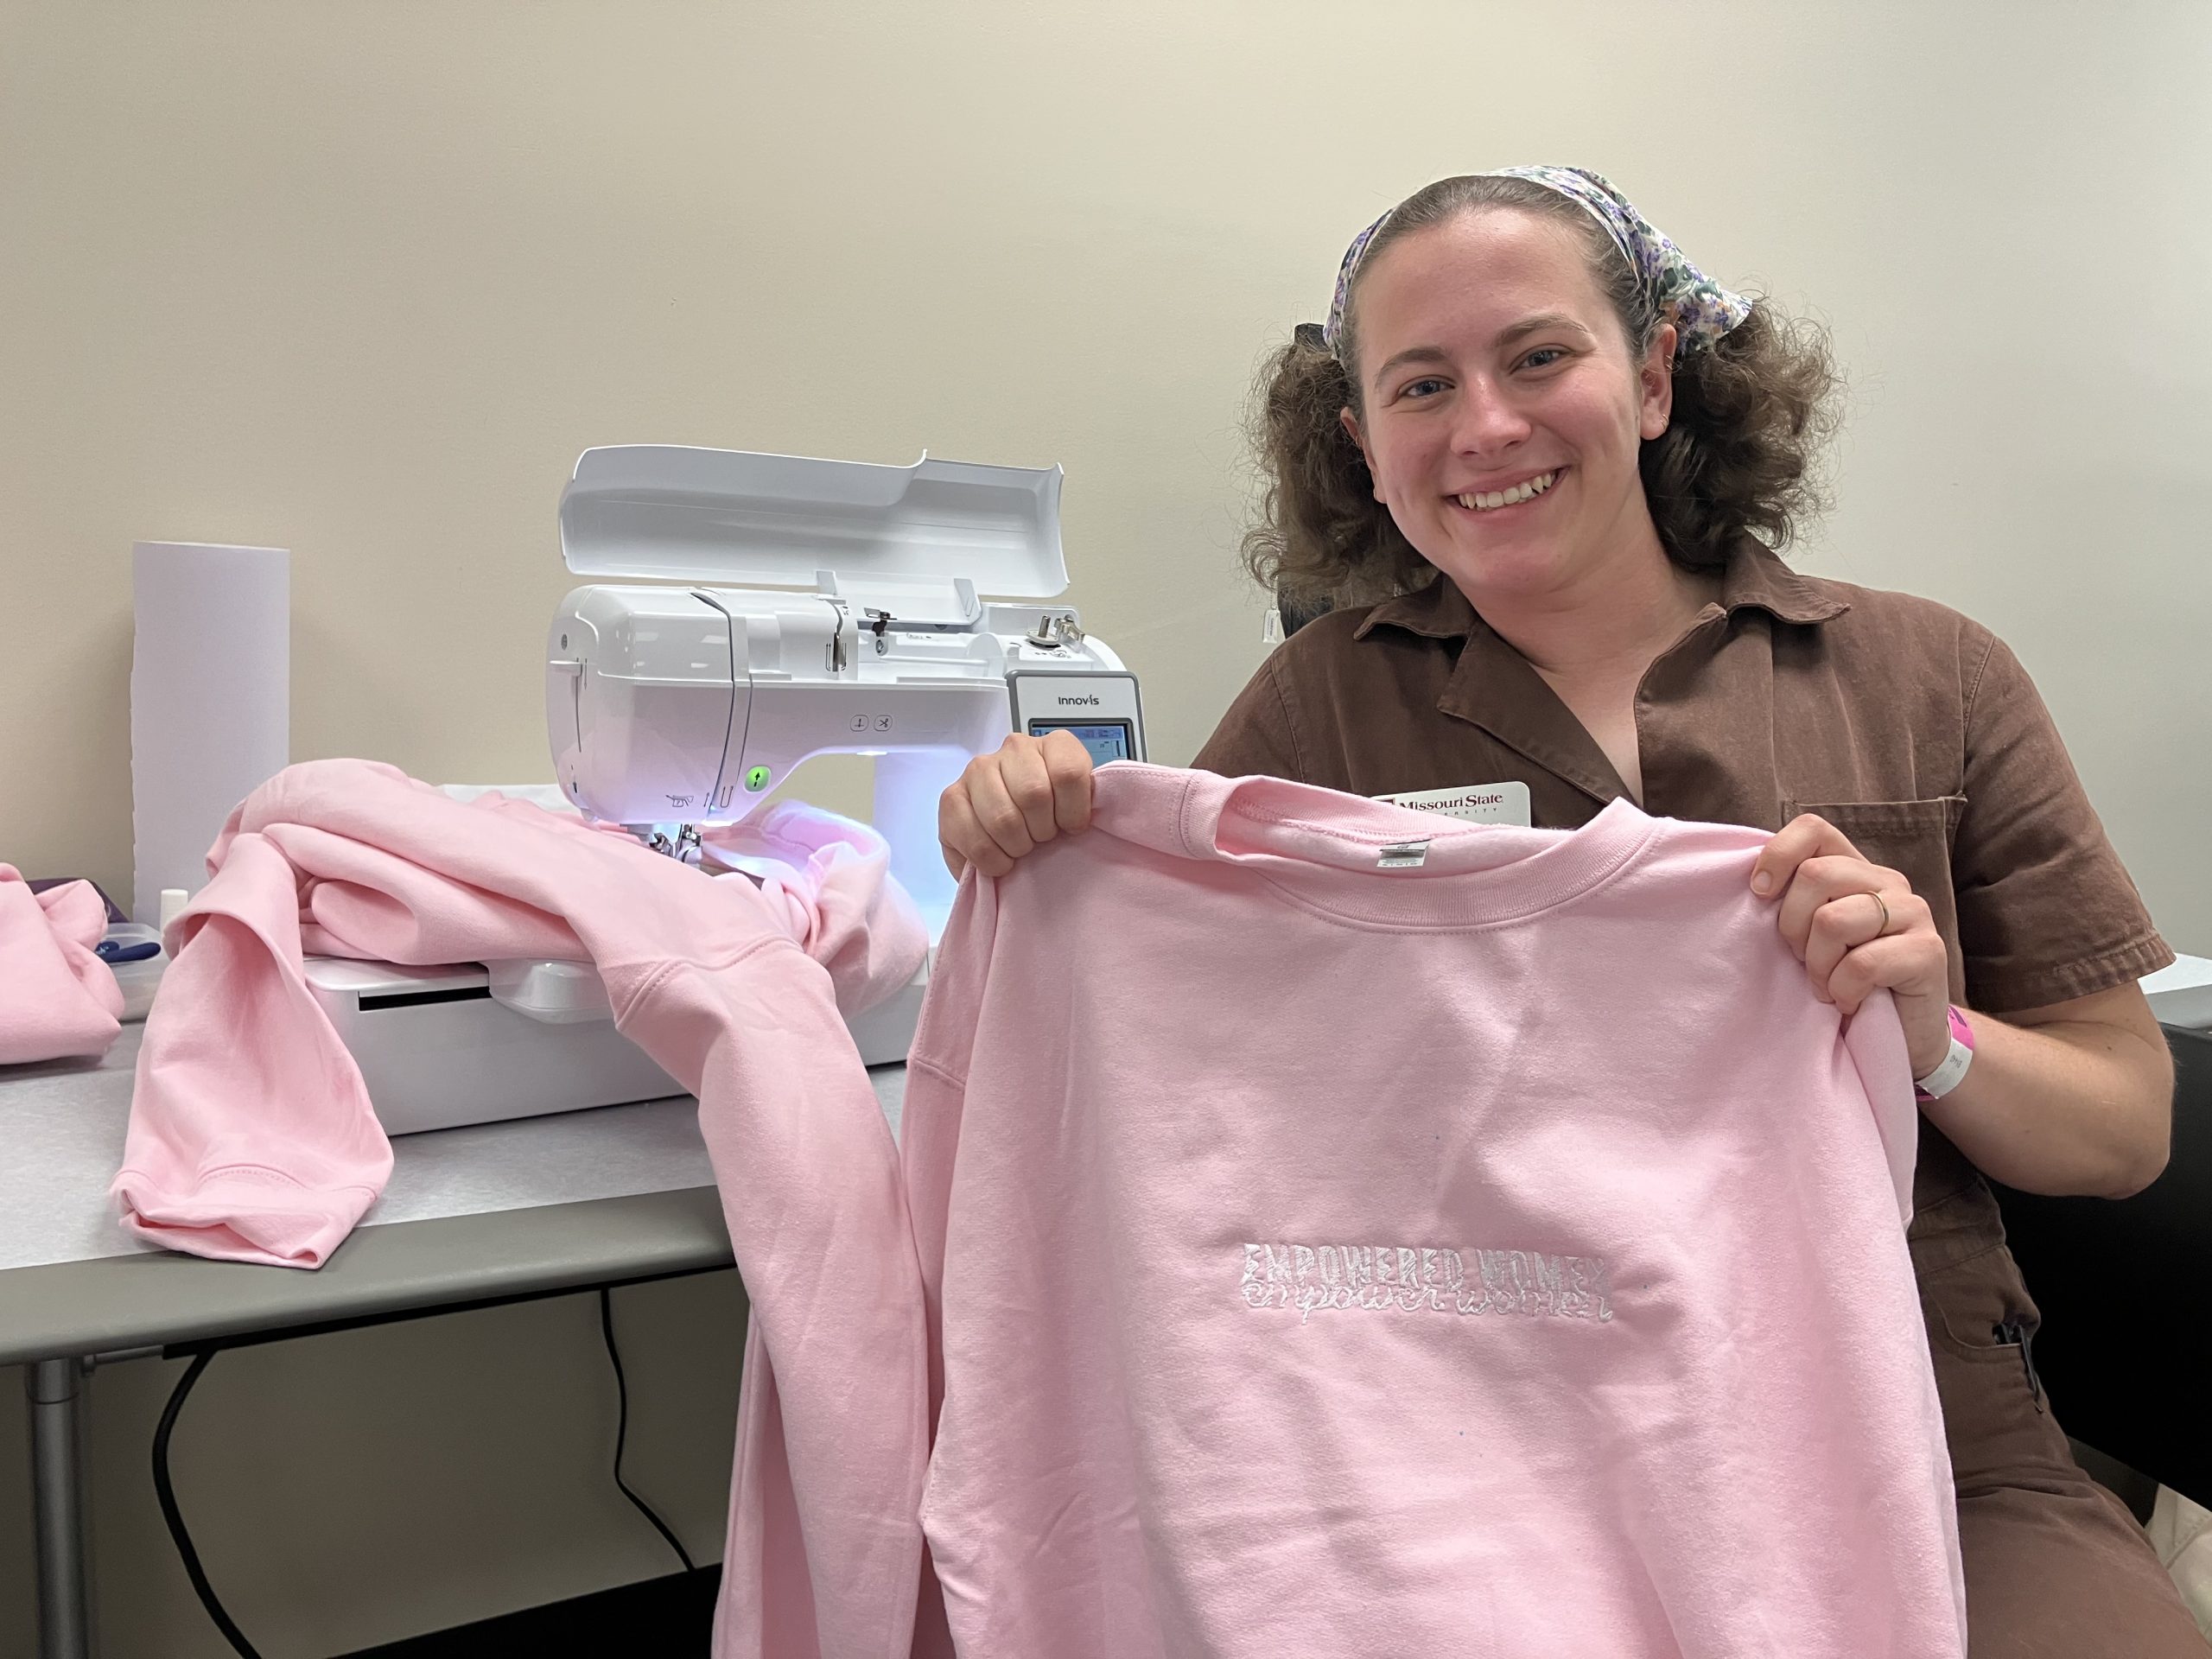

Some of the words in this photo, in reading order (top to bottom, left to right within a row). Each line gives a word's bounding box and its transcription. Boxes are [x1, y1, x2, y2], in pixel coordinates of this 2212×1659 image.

[1399, 796, 1463, 811] Missouri
[1465, 794, 1503, 808] State
[1239, 1243, 1465, 1294] EMPOWERED
